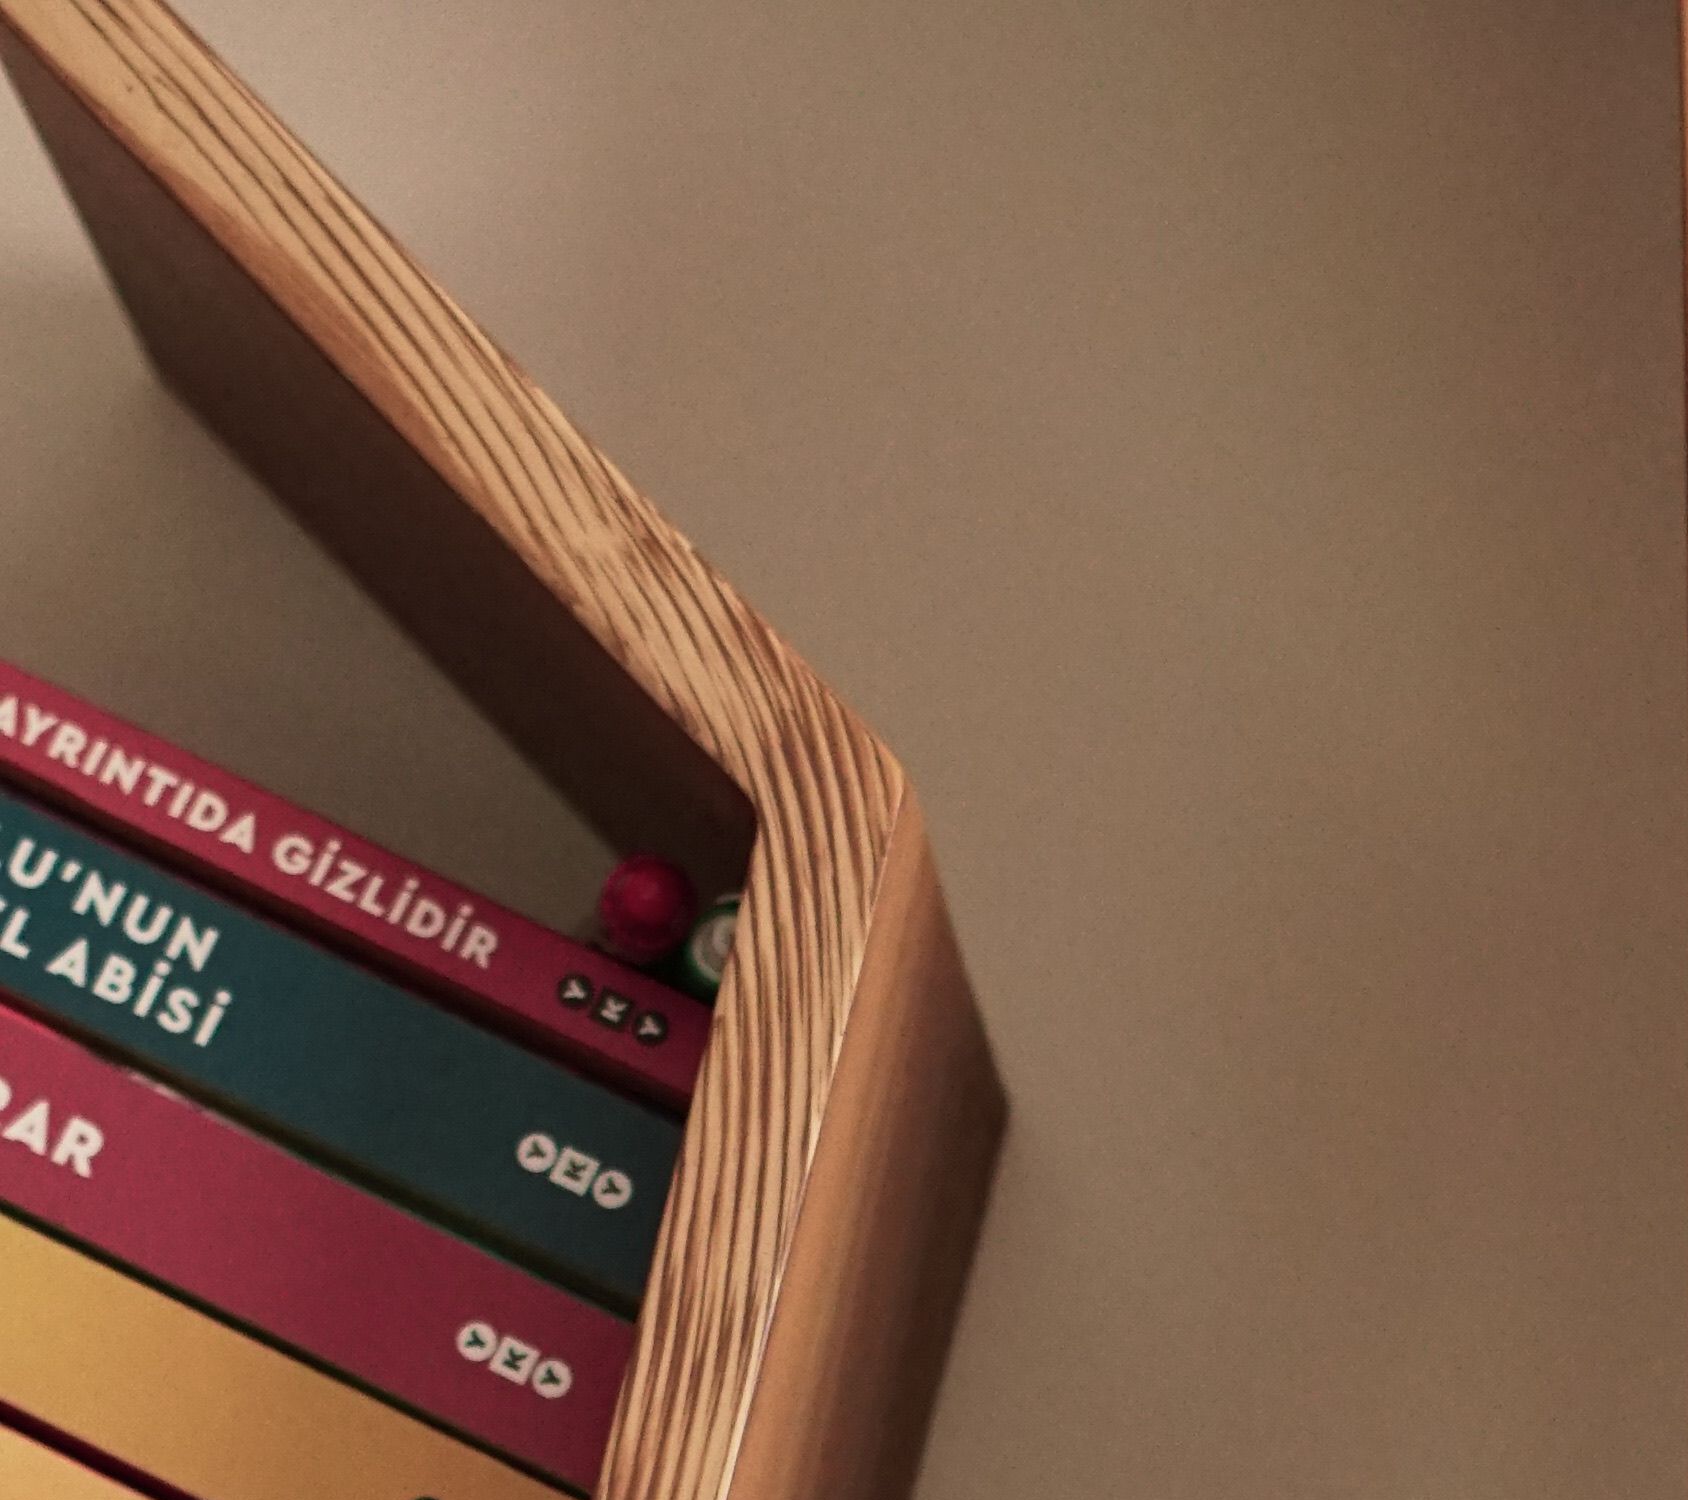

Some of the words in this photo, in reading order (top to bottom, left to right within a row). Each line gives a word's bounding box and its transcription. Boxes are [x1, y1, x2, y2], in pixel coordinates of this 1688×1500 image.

[0, 694, 257, 855] AYRINTIDA
[273, 832, 499, 970] GİZLİDİR
[0, 836, 220, 972] U'NUN
[0, 896, 31, 959] L
[45, 937, 233, 1047] ABİSİ
[559, 977, 665, 1042] YKY
[521, 1136, 627, 1204] YKY
[460, 1325, 568, 1394] YKY
